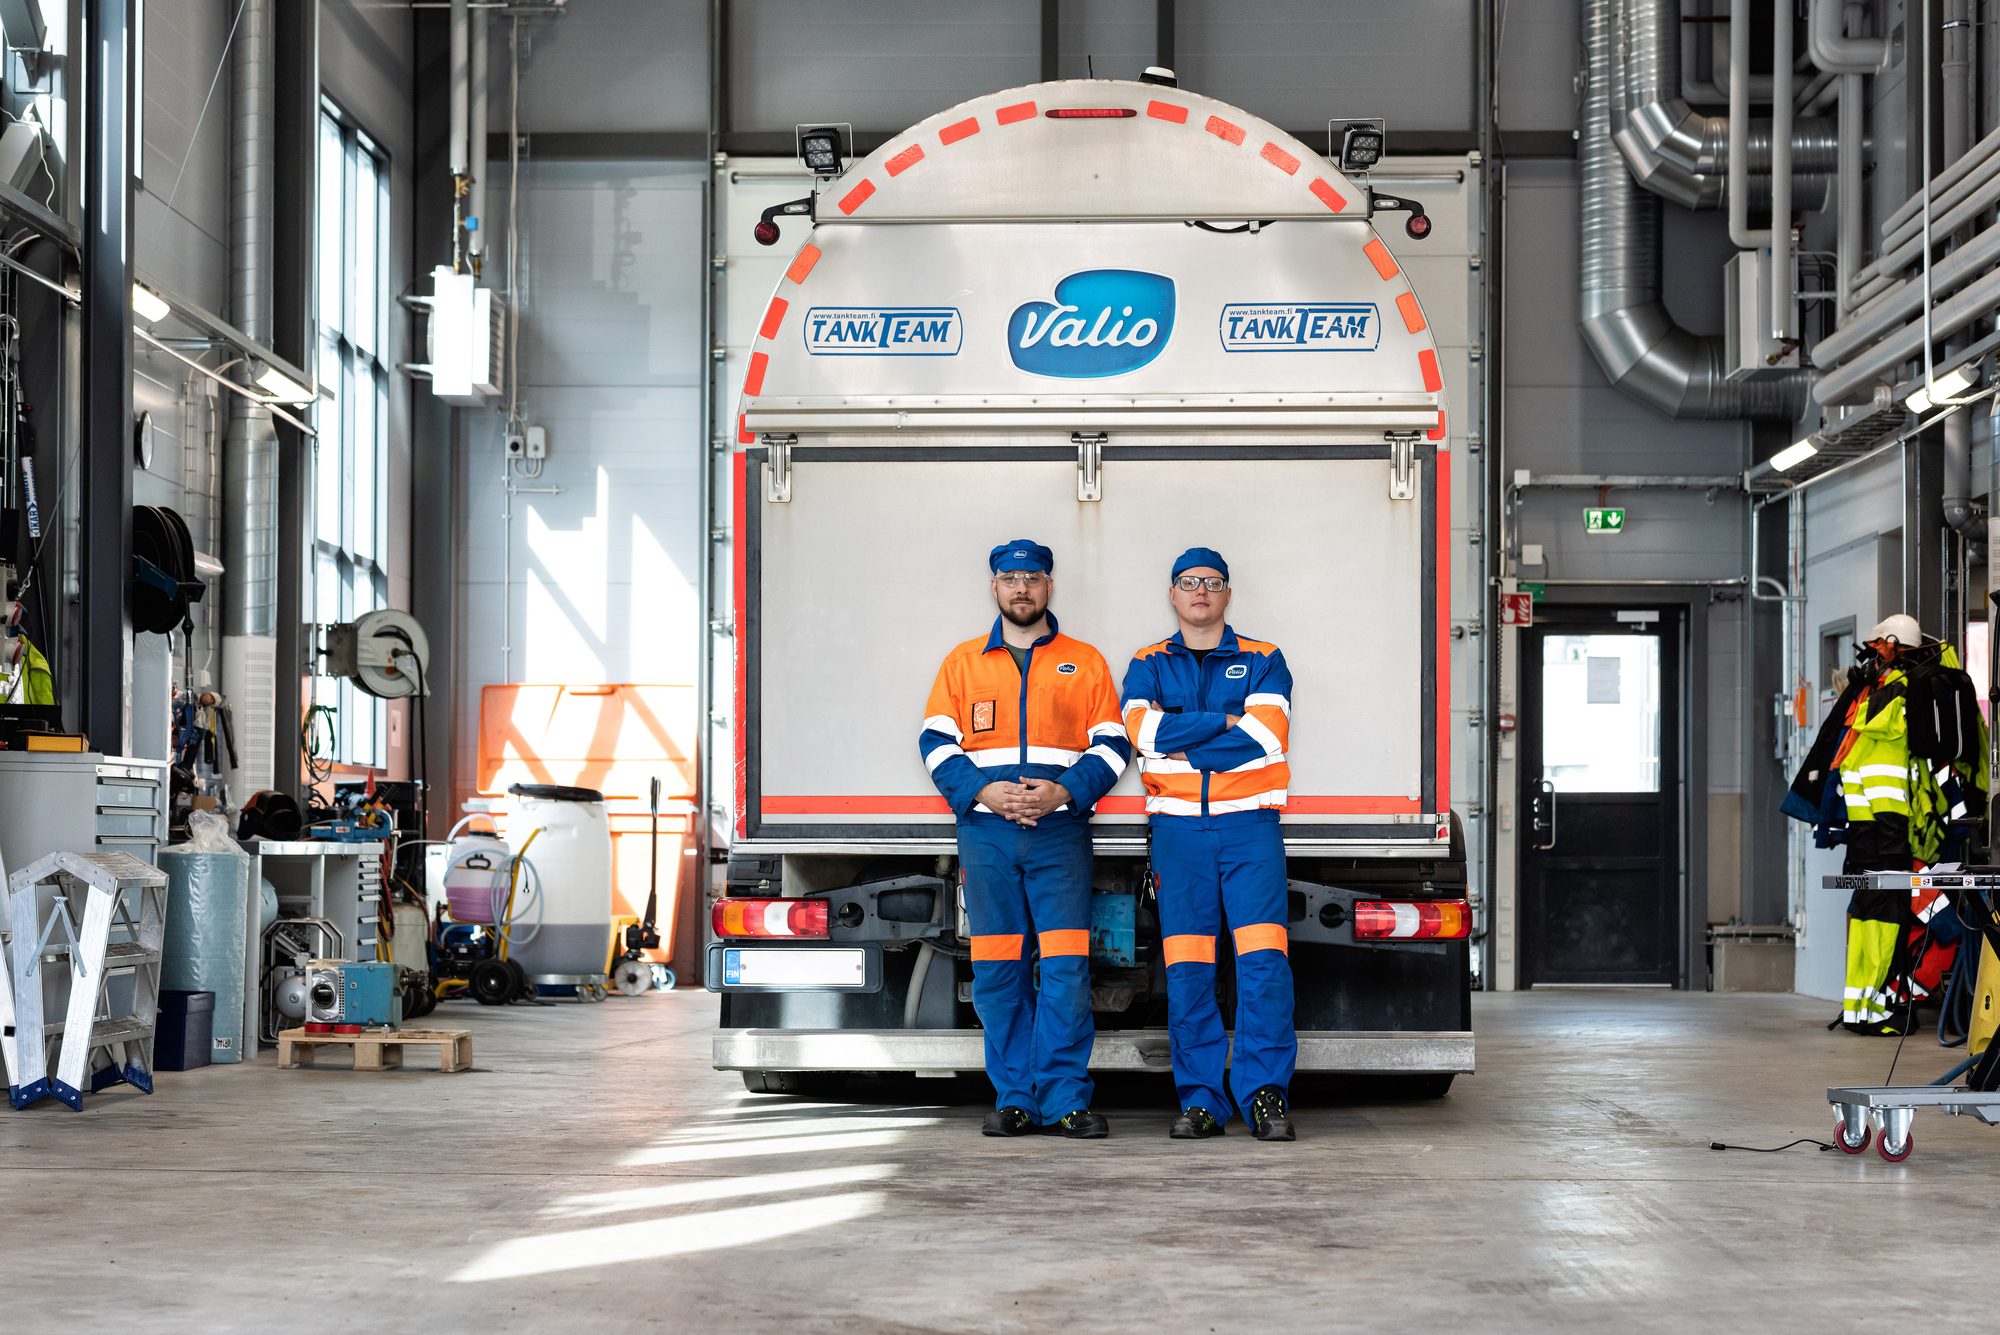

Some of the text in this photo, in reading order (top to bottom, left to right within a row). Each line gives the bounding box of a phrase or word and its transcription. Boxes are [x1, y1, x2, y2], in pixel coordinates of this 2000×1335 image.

[1229, 308, 1293, 316] www.tankteam.fi
[1019, 305, 1158, 349] Valio
[726, 970, 740, 978] FIN
